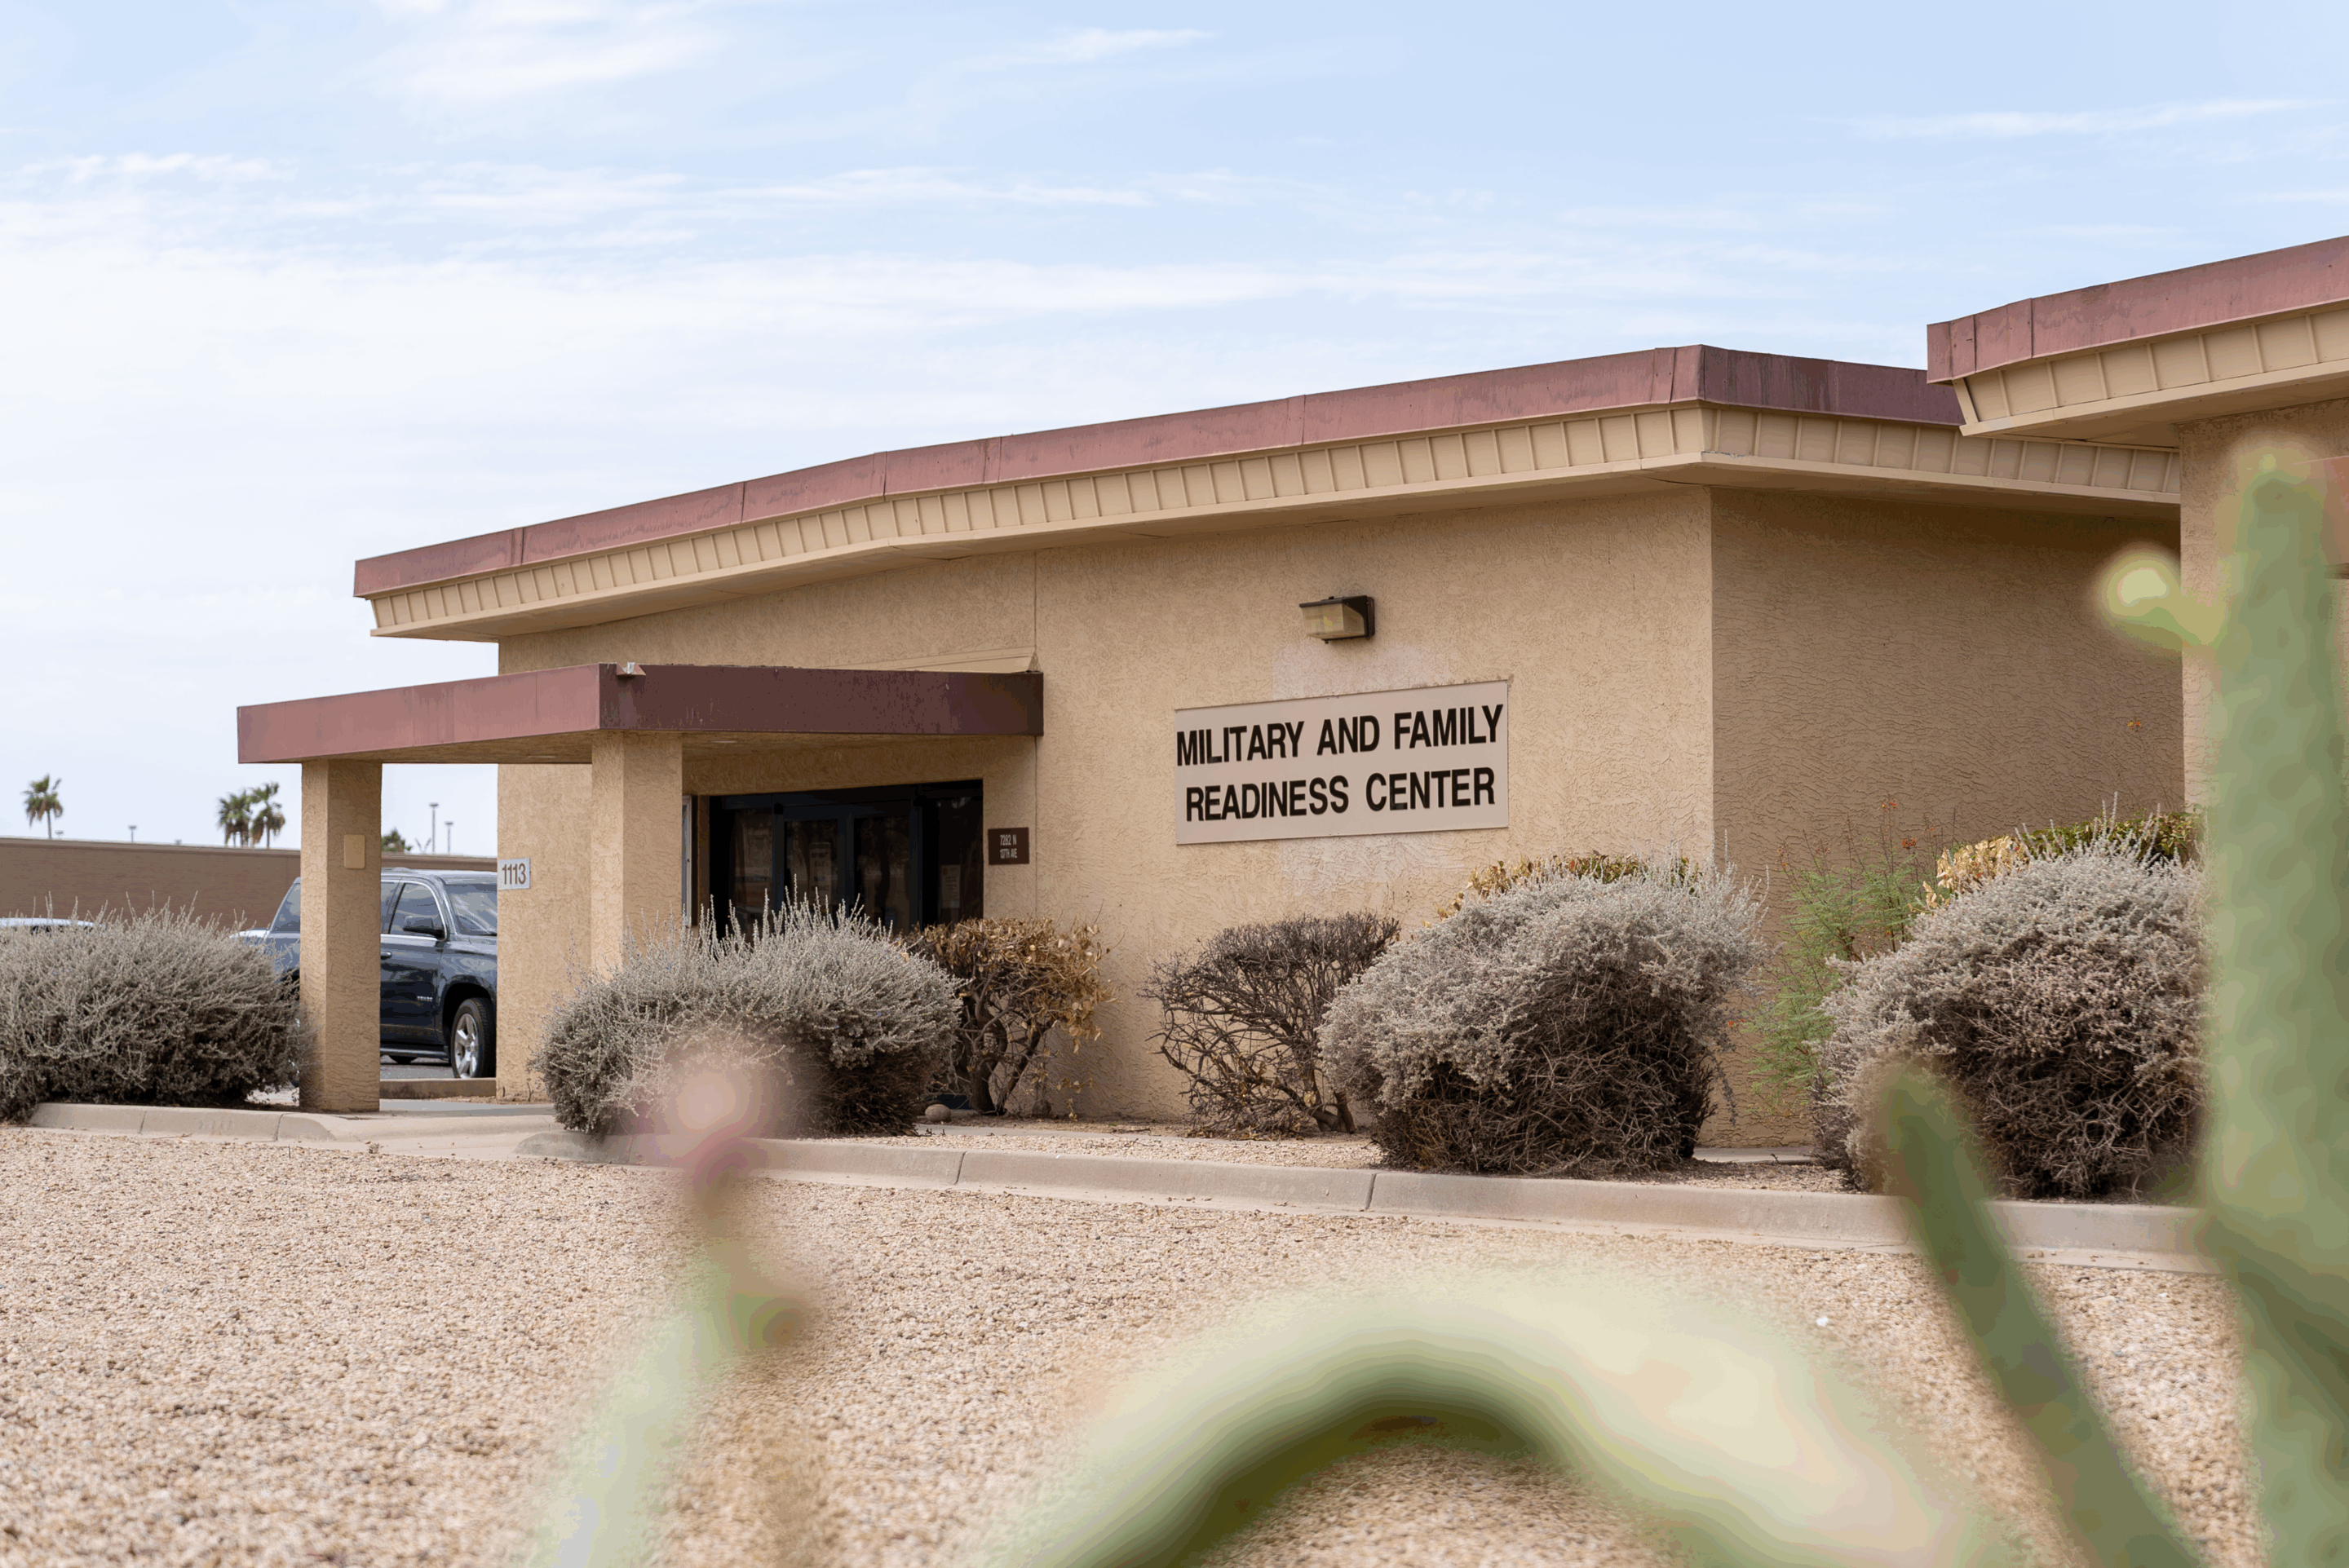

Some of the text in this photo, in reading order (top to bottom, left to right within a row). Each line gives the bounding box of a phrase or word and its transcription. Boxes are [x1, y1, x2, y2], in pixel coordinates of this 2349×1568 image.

[1176, 704, 1503, 766] MILITARY AND FAMILY
[1186, 766, 1495, 822] READINESS CENTER
[1000, 834, 1017, 846] 7282 N
[502, 863, 526, 885] 1113
